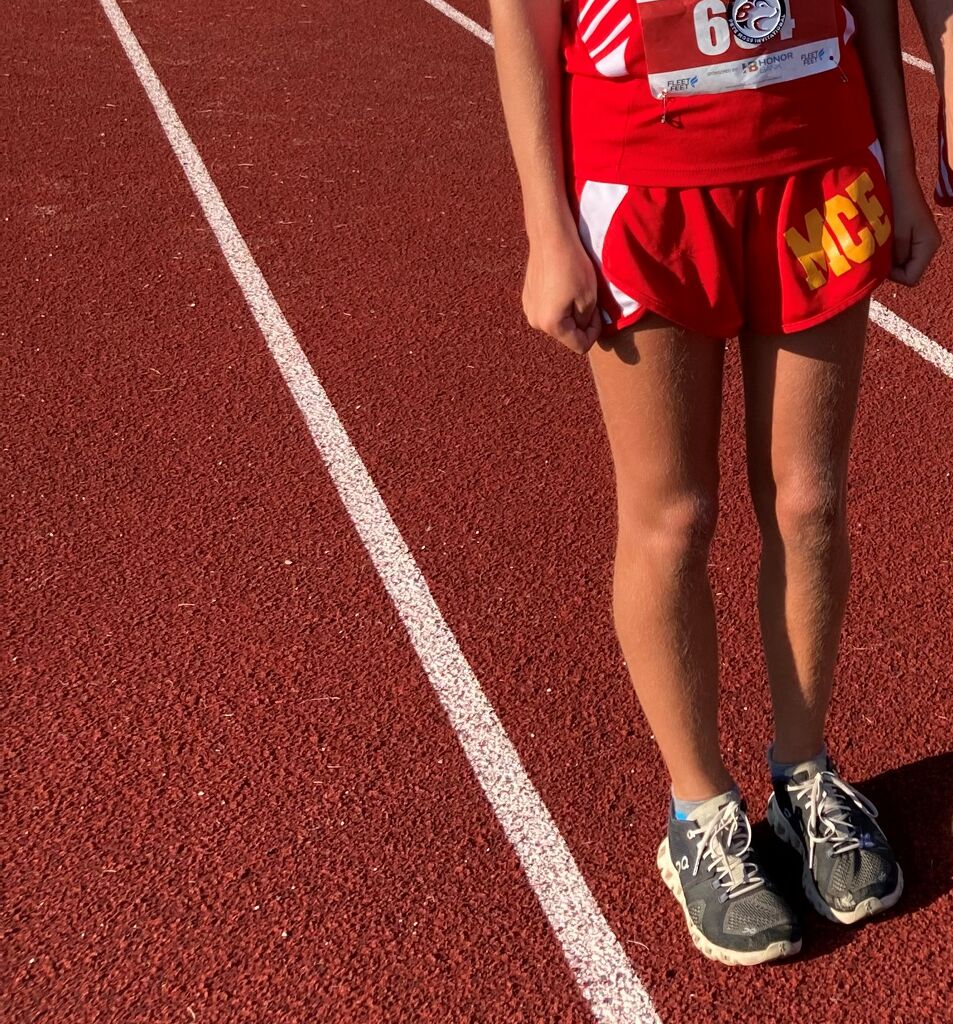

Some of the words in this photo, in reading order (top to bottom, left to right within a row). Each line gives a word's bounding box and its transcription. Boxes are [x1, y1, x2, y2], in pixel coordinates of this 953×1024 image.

[758, 51, 793, 67] HONOR
[800, 50, 819, 61] FLEET
[803, 56, 817, 66] FEET
[667, 77, 690, 87] FLEET
[670, 84, 689, 92] FEET
[783, 171, 892, 291] MCE
